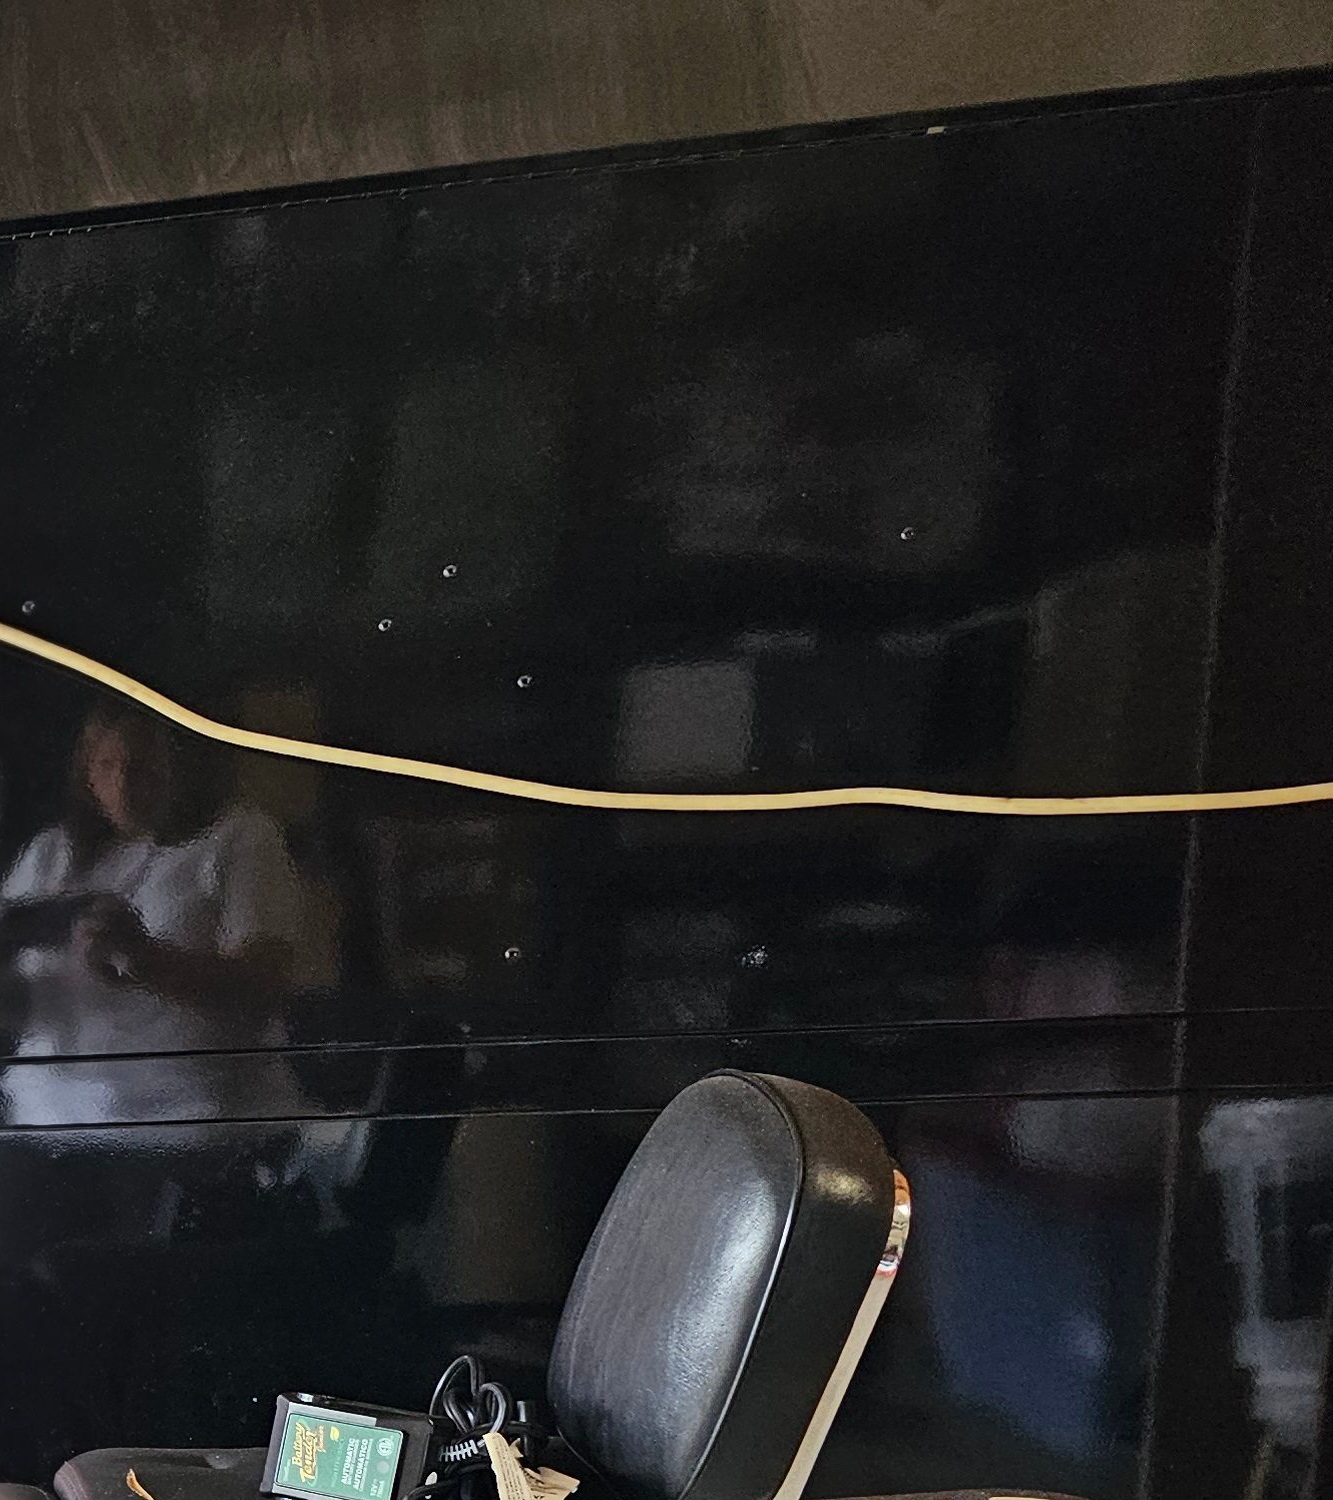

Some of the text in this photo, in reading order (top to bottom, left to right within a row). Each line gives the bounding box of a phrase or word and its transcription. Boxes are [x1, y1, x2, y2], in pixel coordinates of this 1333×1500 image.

[291, 1422, 306, 1468] Battery
[299, 1426, 318, 1483] Tender
[341, 1438, 356, 1486] AUTOMATIC
